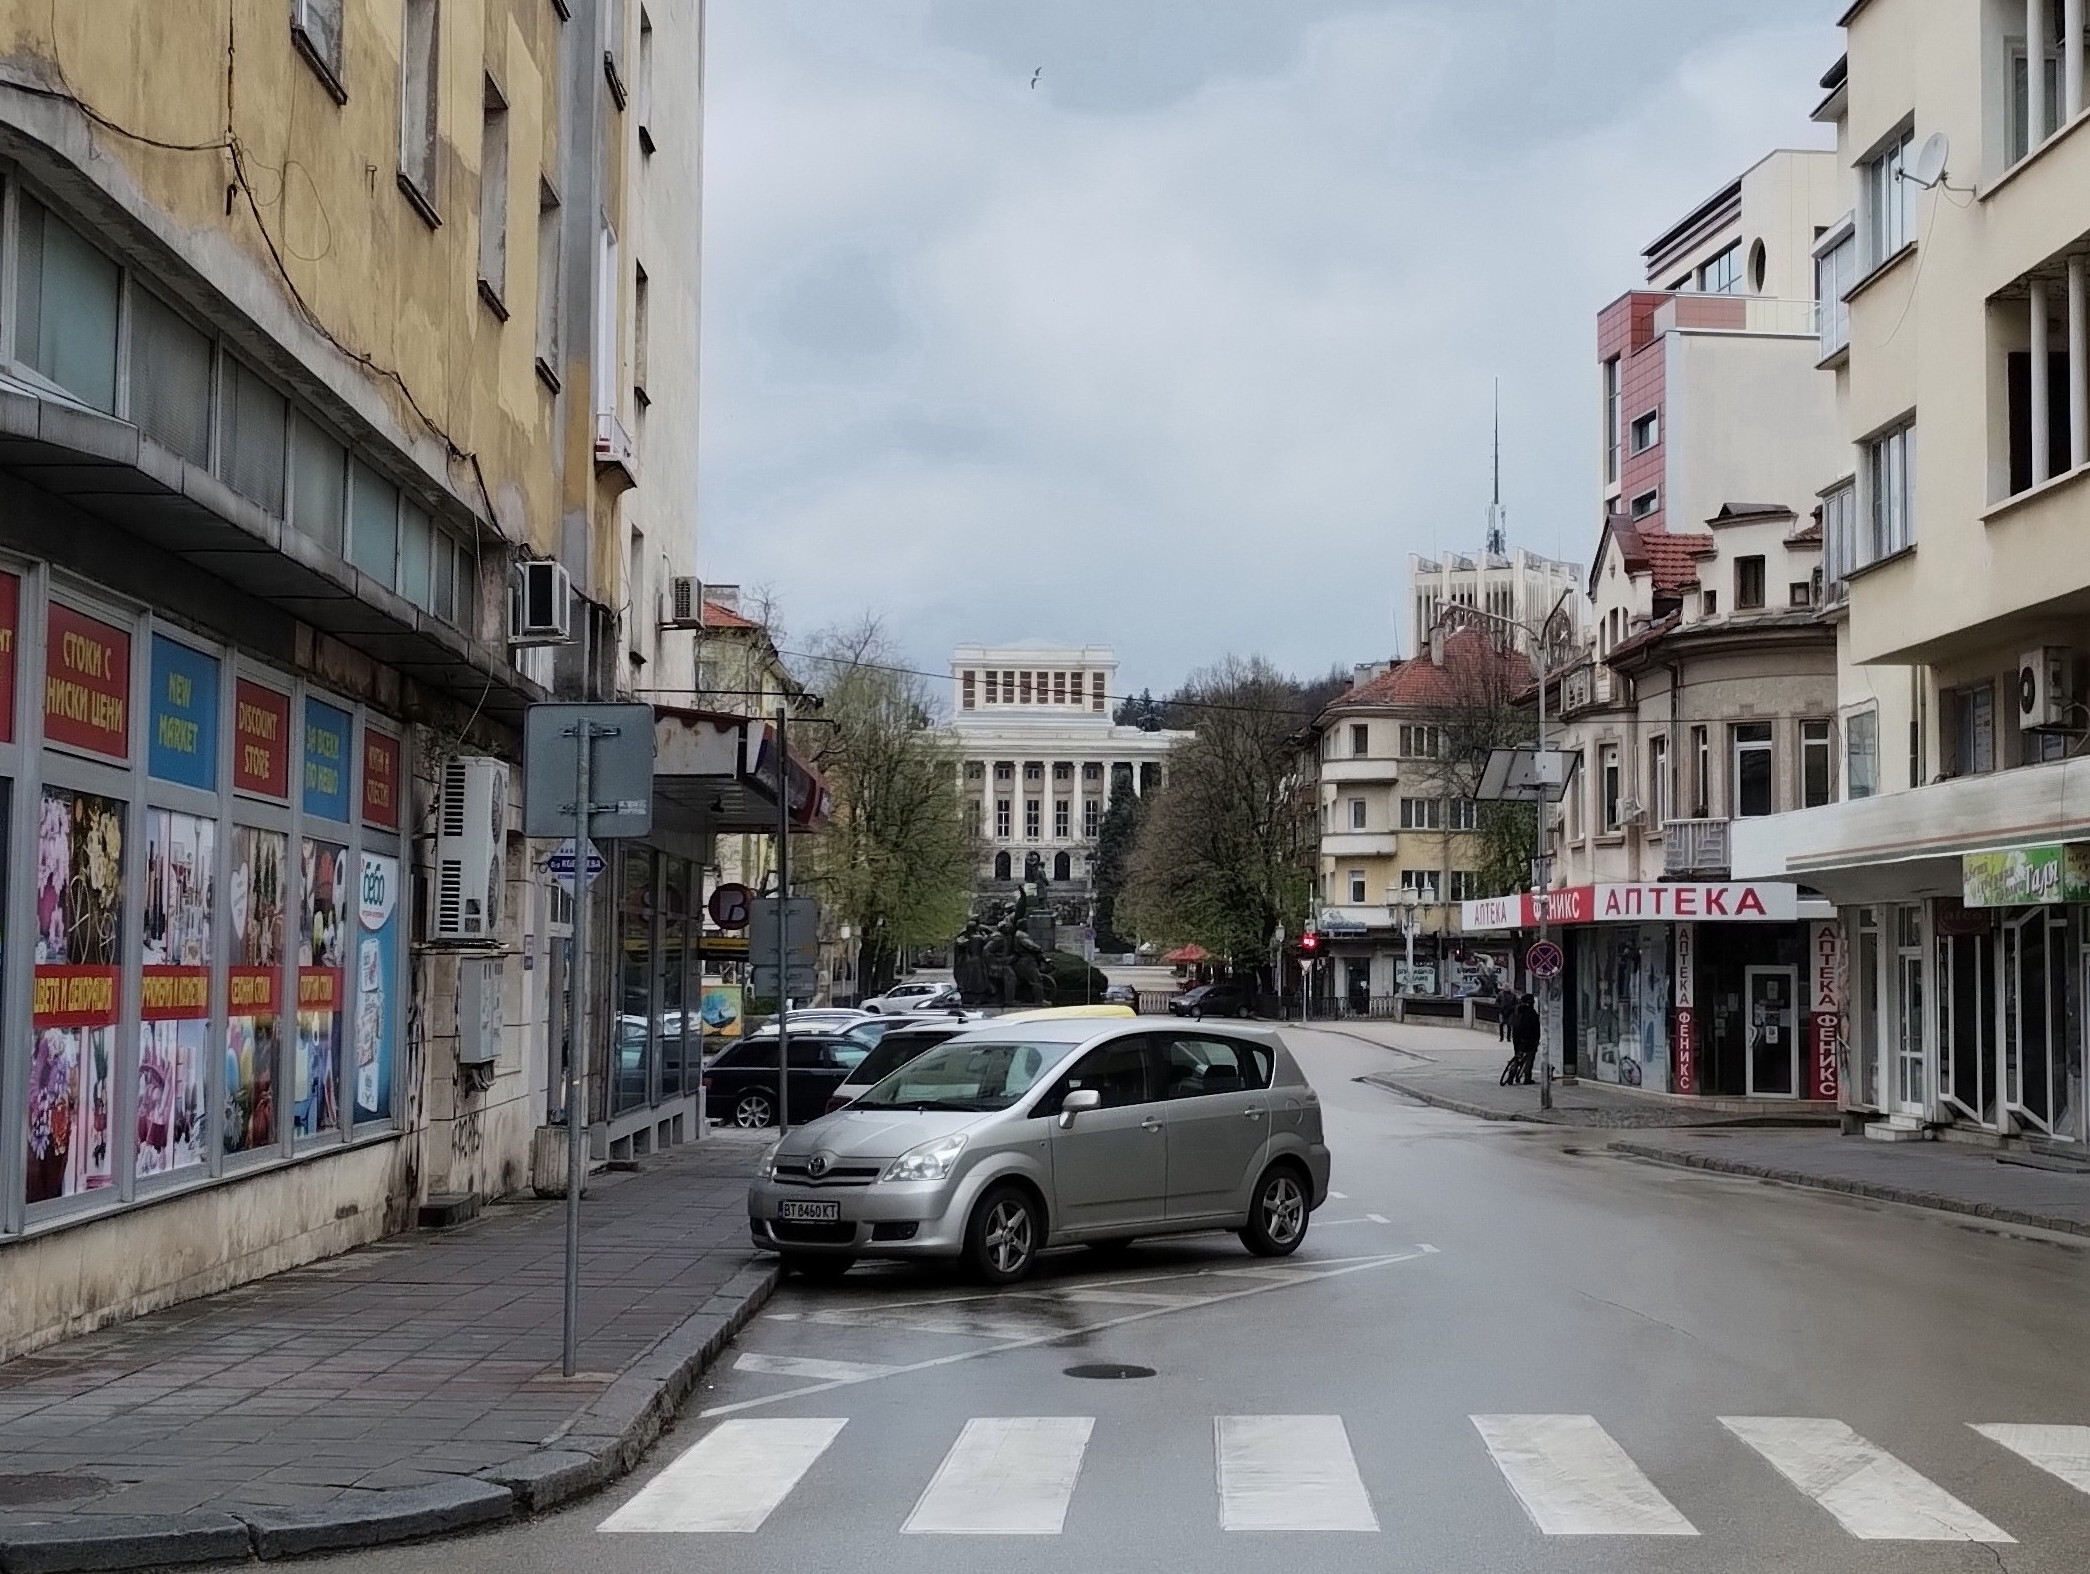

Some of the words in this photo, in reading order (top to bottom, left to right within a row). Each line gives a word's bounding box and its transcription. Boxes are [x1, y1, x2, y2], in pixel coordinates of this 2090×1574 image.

[63, 631, 102, 678] СТОКИ
[46, 675, 88, 723] НИСКИ
[91, 690, 123, 733] ЦЕНИ
[168, 672, 192, 708] NEW
[158, 713, 198, 755] MARKET
[238, 701, 278, 741] DISCOUNT
[244, 744, 270, 780] STORE
[1474, 901, 1507, 926] АПТЕКА
[1533, 891, 1580, 922] ФНИКС
[1605, 887, 1767, 916] АПТЕКА
[1678, 928, 1690, 1005] АПТЕКА
[1818, 926, 1836, 1006] АПТЕКА
[1678, 1011, 1691, 1089] ФЕНИКС
[1817, 1015, 1838, 1095] ФЕНИКС
